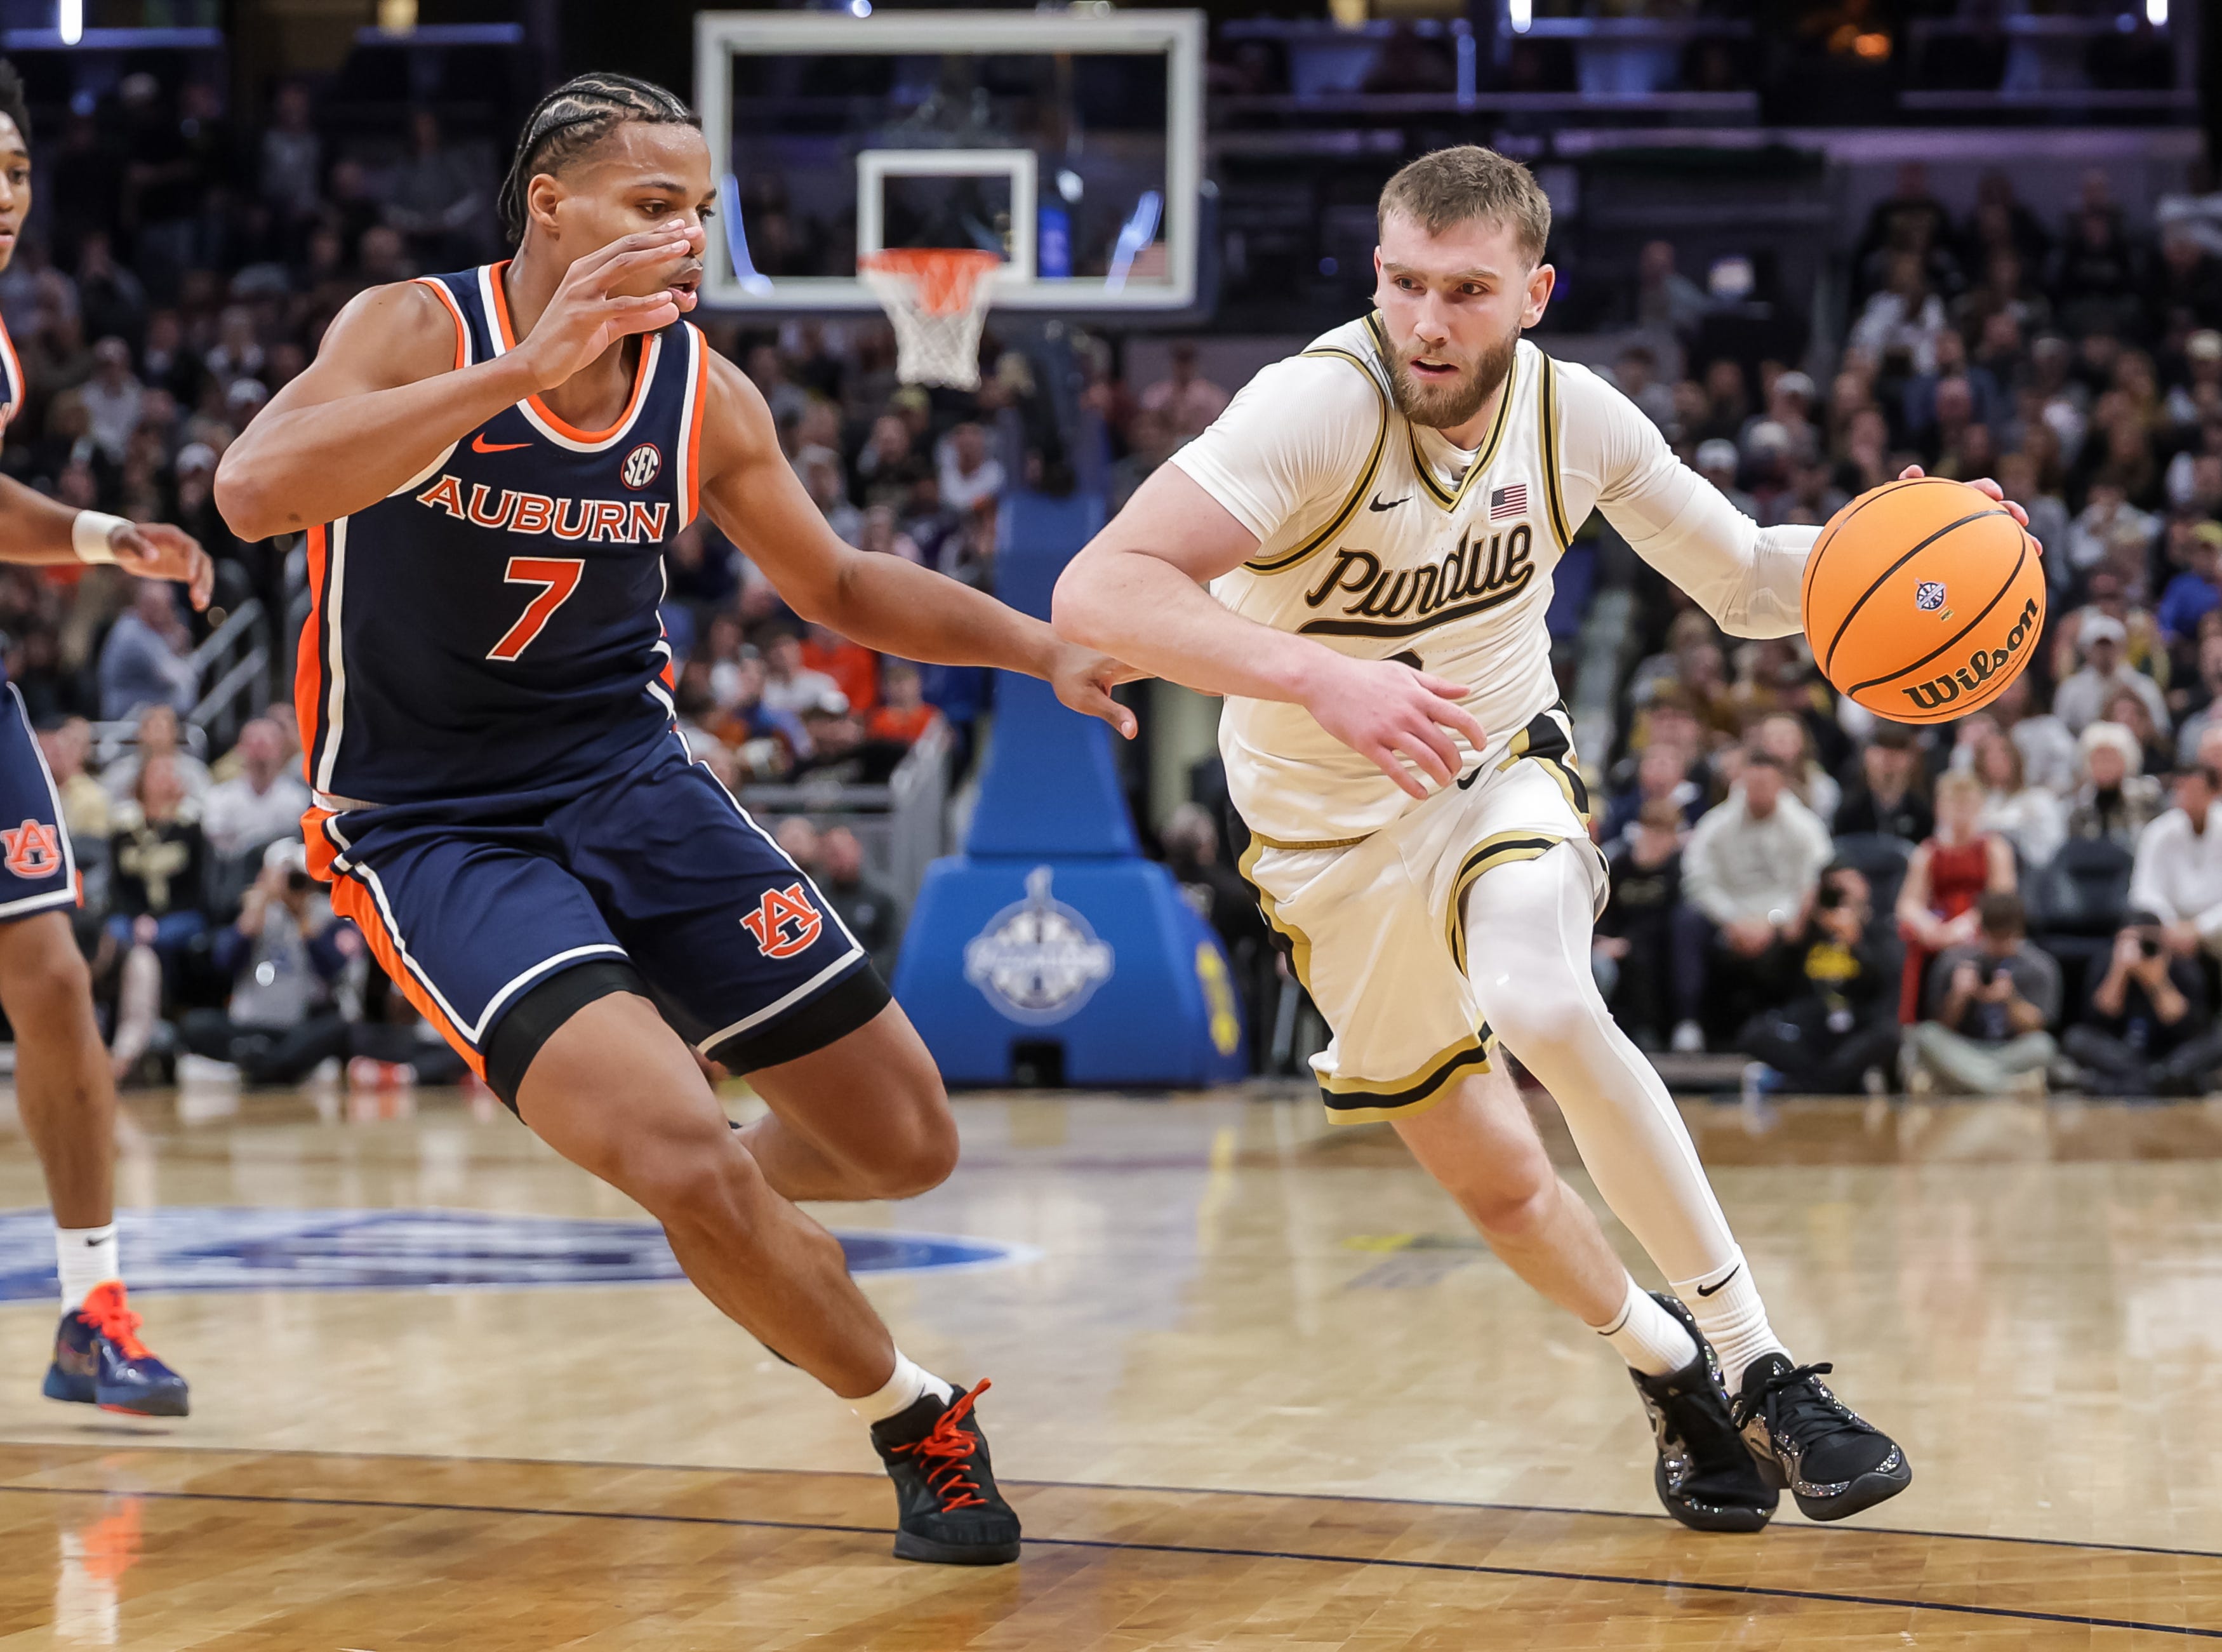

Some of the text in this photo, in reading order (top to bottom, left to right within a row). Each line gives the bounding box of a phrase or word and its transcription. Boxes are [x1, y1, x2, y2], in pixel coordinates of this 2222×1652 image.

[416, 474, 670, 544] AUBURN
[624, 446, 659, 487] SEC
[485, 556, 586, 662] 7
[1304, 522, 1536, 619] Purdue
[1901, 597, 2039, 709] Wilson
